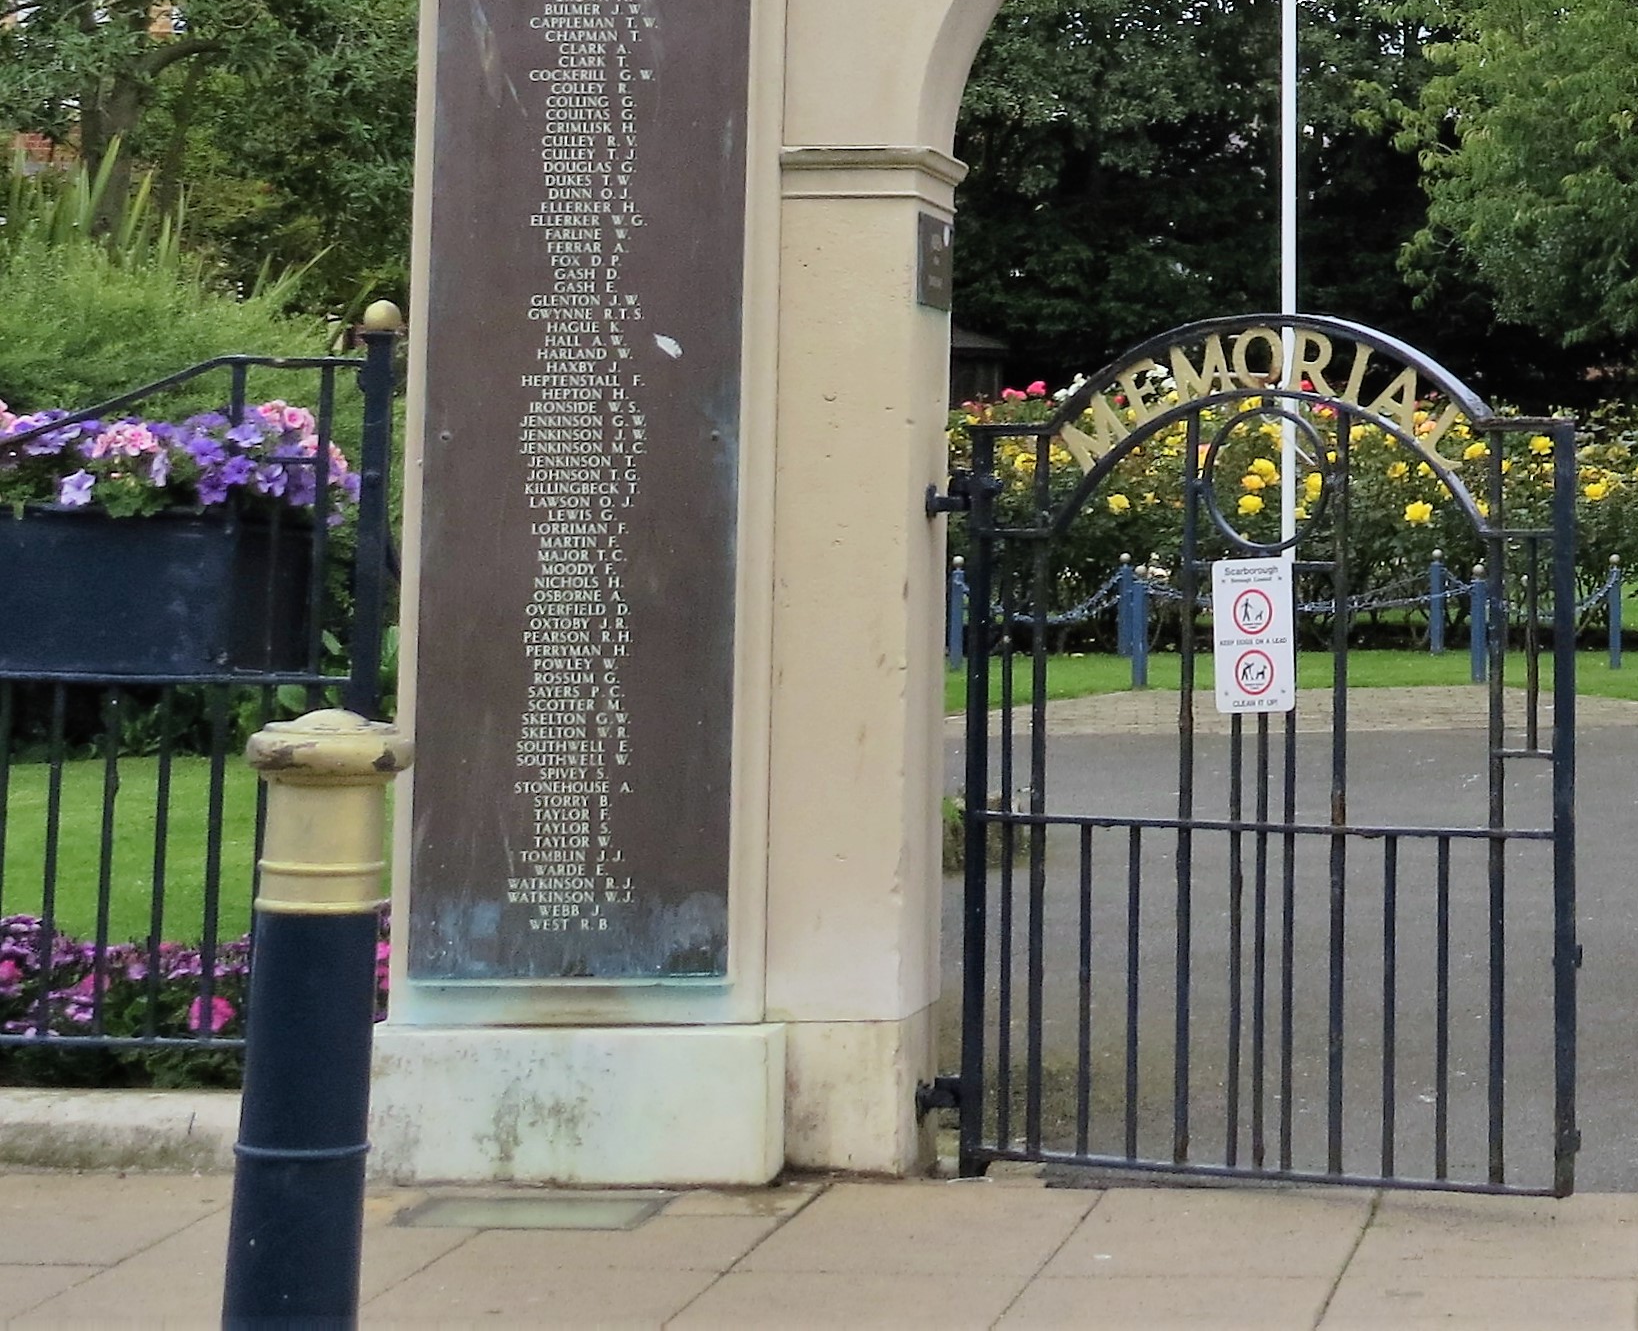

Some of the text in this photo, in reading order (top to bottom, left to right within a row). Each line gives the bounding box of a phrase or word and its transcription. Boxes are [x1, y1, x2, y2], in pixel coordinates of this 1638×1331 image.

[545, 4, 600, 15] BULMER
[530, 18, 614, 28] CAPPLEMAN
[545, 31, 617, 41] CHAPMAN
[559, 43, 606, 54] CLARK
[558, 56, 605, 67] CLARK
[529, 70, 606, 81] COCKERILL
[551, 83, 604, 94] COLLEY
[546, 96, 608, 107] COLLING
[546, 109, 610, 120] COULTAS
[546, 122, 611, 133] CRIMLISK
[542, 136, 595, 146] CULLEY
[542, 149, 595, 160] CULLEY
[544, 162, 611, 173] DOUGLAS
[545, 175, 591, 186] DUKES
[549, 188, 591, 199] DUNN
[541, 202, 611, 213] ELLERKER
[530, 215, 599, 226] ELLERKER
[545, 229, 601, 240] FARLINE
[551, 255, 580, 266] FOX
[554, 269, 595, 279] GASH
[554, 282, 594, 292] GASH
[531, 295, 600, 306] GLENTON
[547, 322, 599, 333] HAGUE
[545, 336, 580, 346] HALL
[537, 348, 607, 359] HARLAND
[547, 362, 596, 372] HAXBY
[522, 375, 620, 386] HEPTENSTALL
[542, 389, 601, 399] HEPTON
[1060, 326, 1462, 475] MEMORIAL
[530, 402, 596, 413] IRONSIDE
[520, 416, 602, 426] JENKINSON
[519, 430, 602, 440] JENKINSON
[519, 443, 602, 454] JENKINSON
[528, 456, 611, 467] JENKINSON
[527, 470, 600, 481] JOHNSON
[525, 483, 619, 494] KILLINGBECK
[530, 497, 589, 508] LAWSON
[548, 510, 591, 521] LEWIS
[532, 523, 607, 534] LORRIMAN
[541, 537, 596, 547] MARTIN
[538, 550, 588, 561] MAJOR
[542, 564, 596, 574] MOODY
[1224, 566, 1279, 577] Scarborough
[535, 577, 598, 588] NICHOLS
[533, 590, 601, 601] OSBORNE
[526, 604, 606, 615] OVERFIELD
[523, 632, 589, 643] PEARSON
[534, 673, 593, 684] ROSSUM
[528, 686, 579, 698] SAYERS
[528, 699, 594, 711] SCOTTER
[522, 713, 585, 725] SKELTON
[522, 727, 585, 739] SKELTON
[517, 741, 605, 752] SOUTHWELL
[515, 781, 609, 793] STONEHOUSE
[535, 796, 588, 807] STORRY
[534, 809, 589, 820] TAYLOR
[534, 823, 589, 834] TAYLOR
[534, 836, 589, 847] TAYLOR
[520, 851, 585, 861] TOMBLIN
[529, 919, 569, 930] WEST
